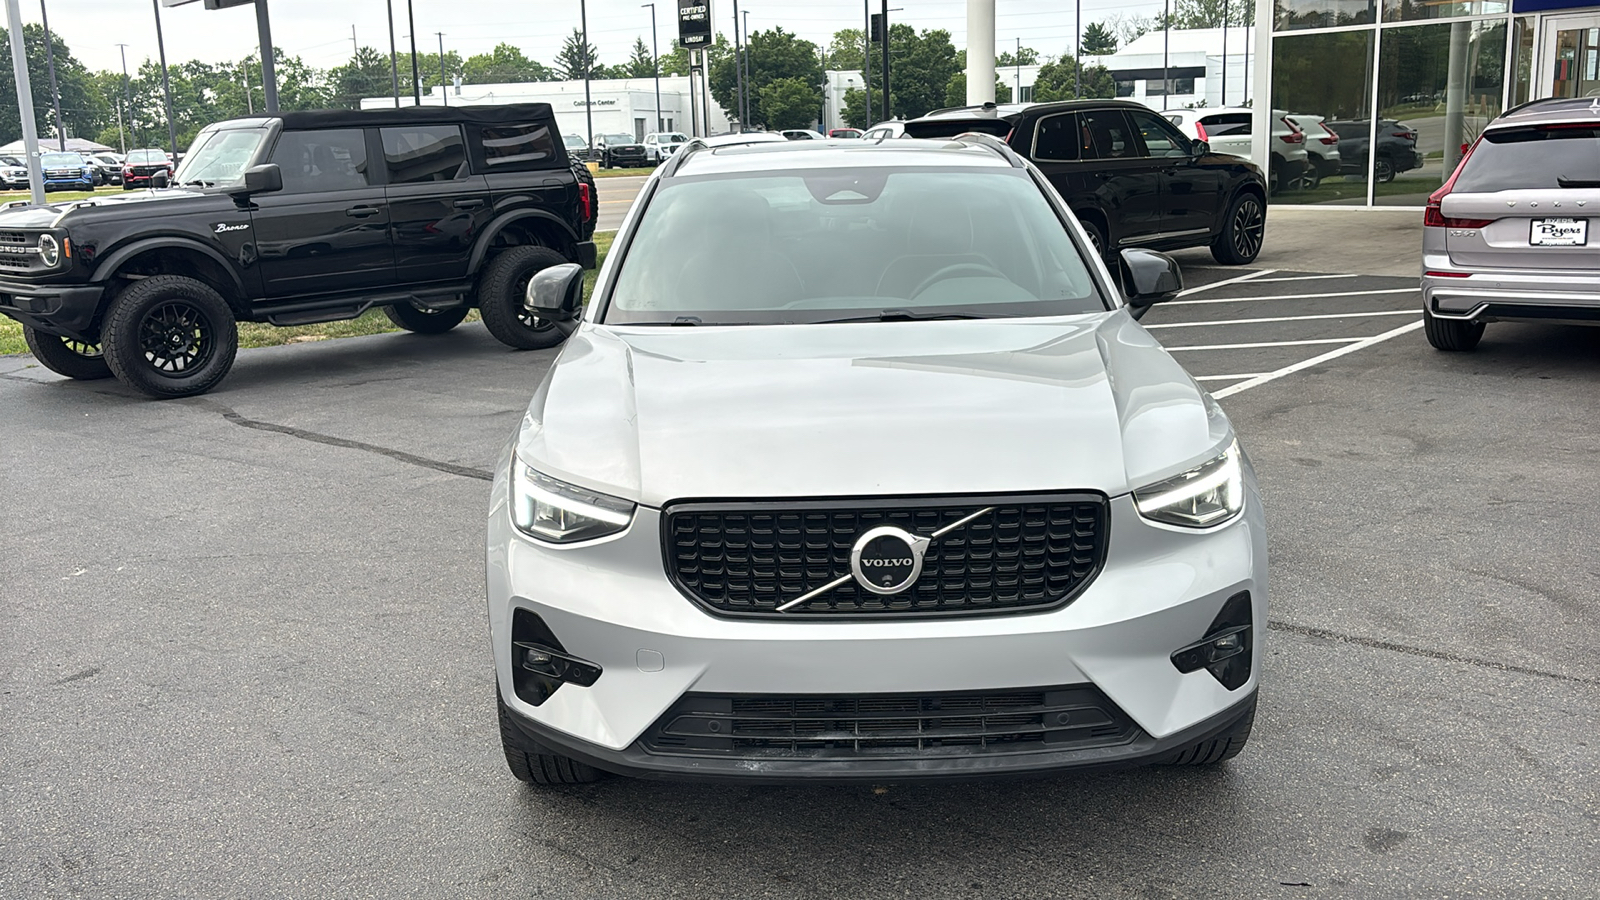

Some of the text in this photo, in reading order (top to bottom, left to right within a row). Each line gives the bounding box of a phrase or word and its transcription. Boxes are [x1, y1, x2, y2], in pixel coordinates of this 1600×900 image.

[680, 5, 707, 15] CERTIFIED
[682, 13, 705, 21] PRE-OWNED
[684, 35, 704, 44] LINDSAY
[214, 223, 250, 233] Bronco
[1536, 223, 1581, 238] Byers
[861, 557, 913, 567] VOLVO
